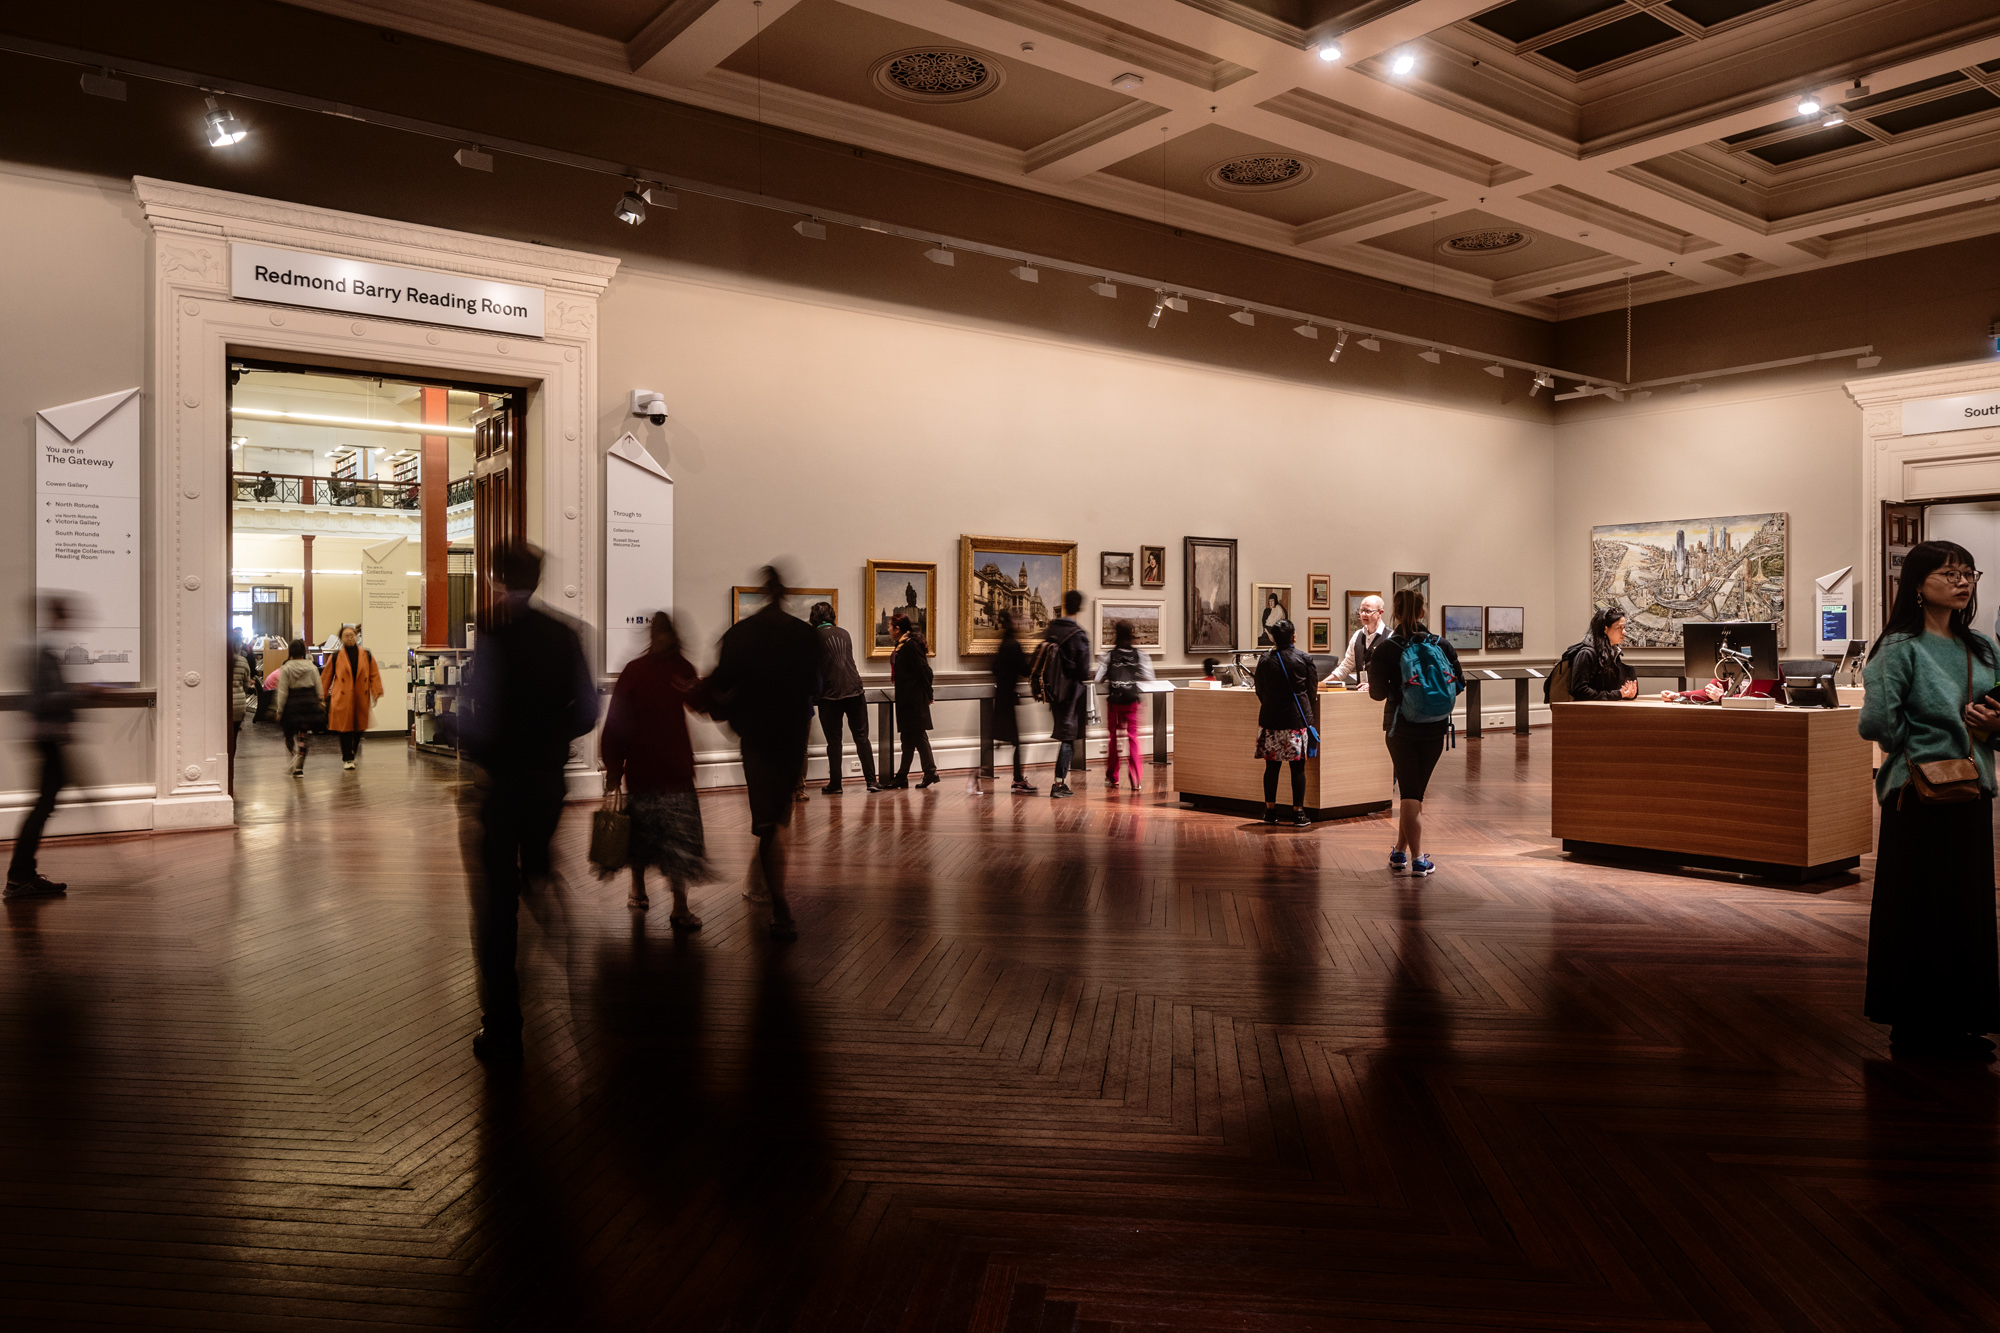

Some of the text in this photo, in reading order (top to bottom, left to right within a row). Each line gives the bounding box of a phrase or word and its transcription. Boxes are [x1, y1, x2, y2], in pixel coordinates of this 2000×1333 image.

[255, 265, 528, 318] Redmond Barry Reading Room
[46, 454, 114, 468] The Gateway
